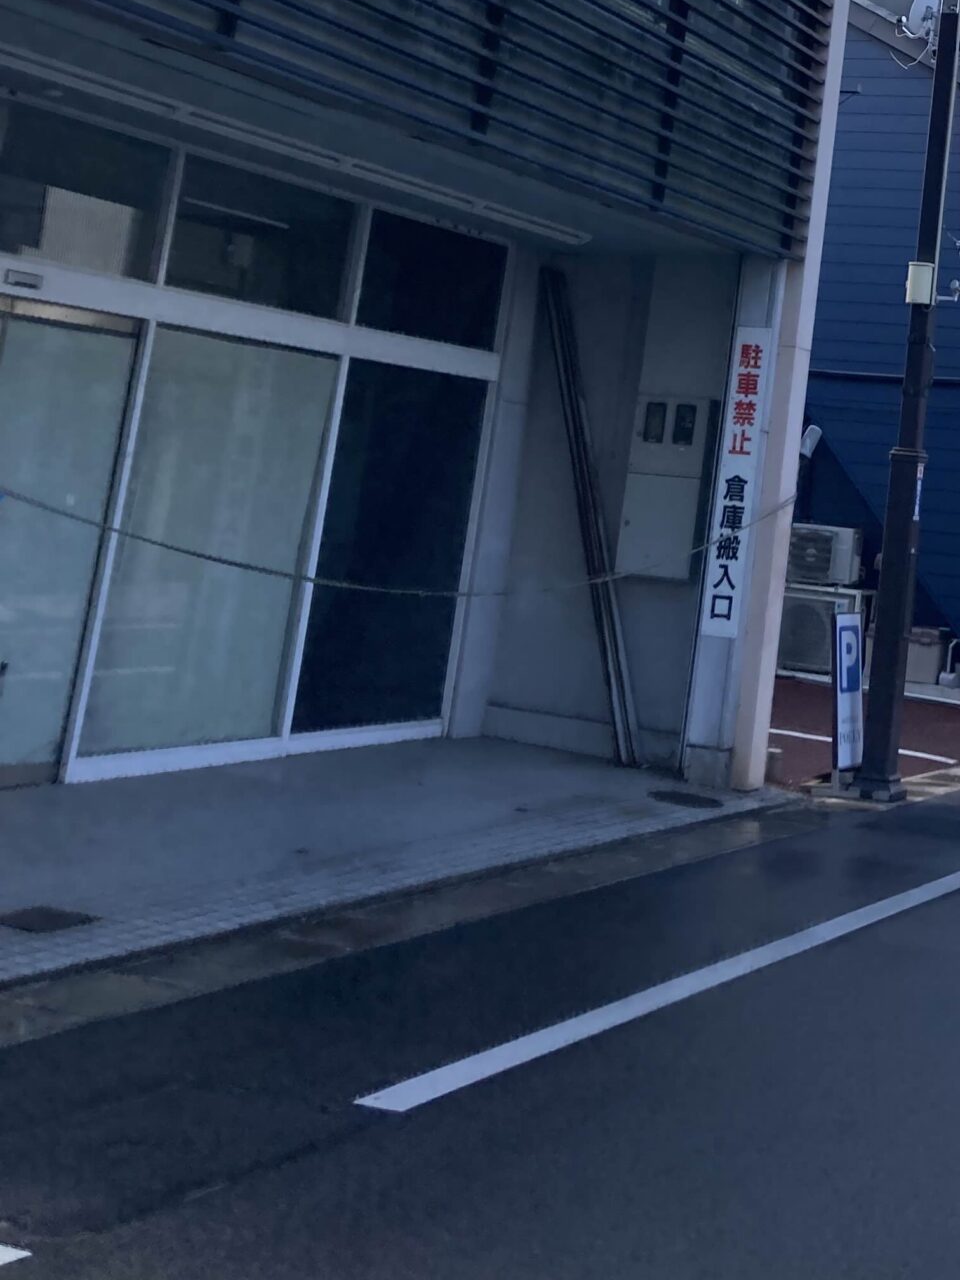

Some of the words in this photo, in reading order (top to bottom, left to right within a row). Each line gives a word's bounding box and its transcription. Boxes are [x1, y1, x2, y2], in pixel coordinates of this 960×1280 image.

[728, 343, 763, 457] 駐車禁止
[710, 474, 749, 621] 倉庫搬入口
[841, 630, 857, 689] P
